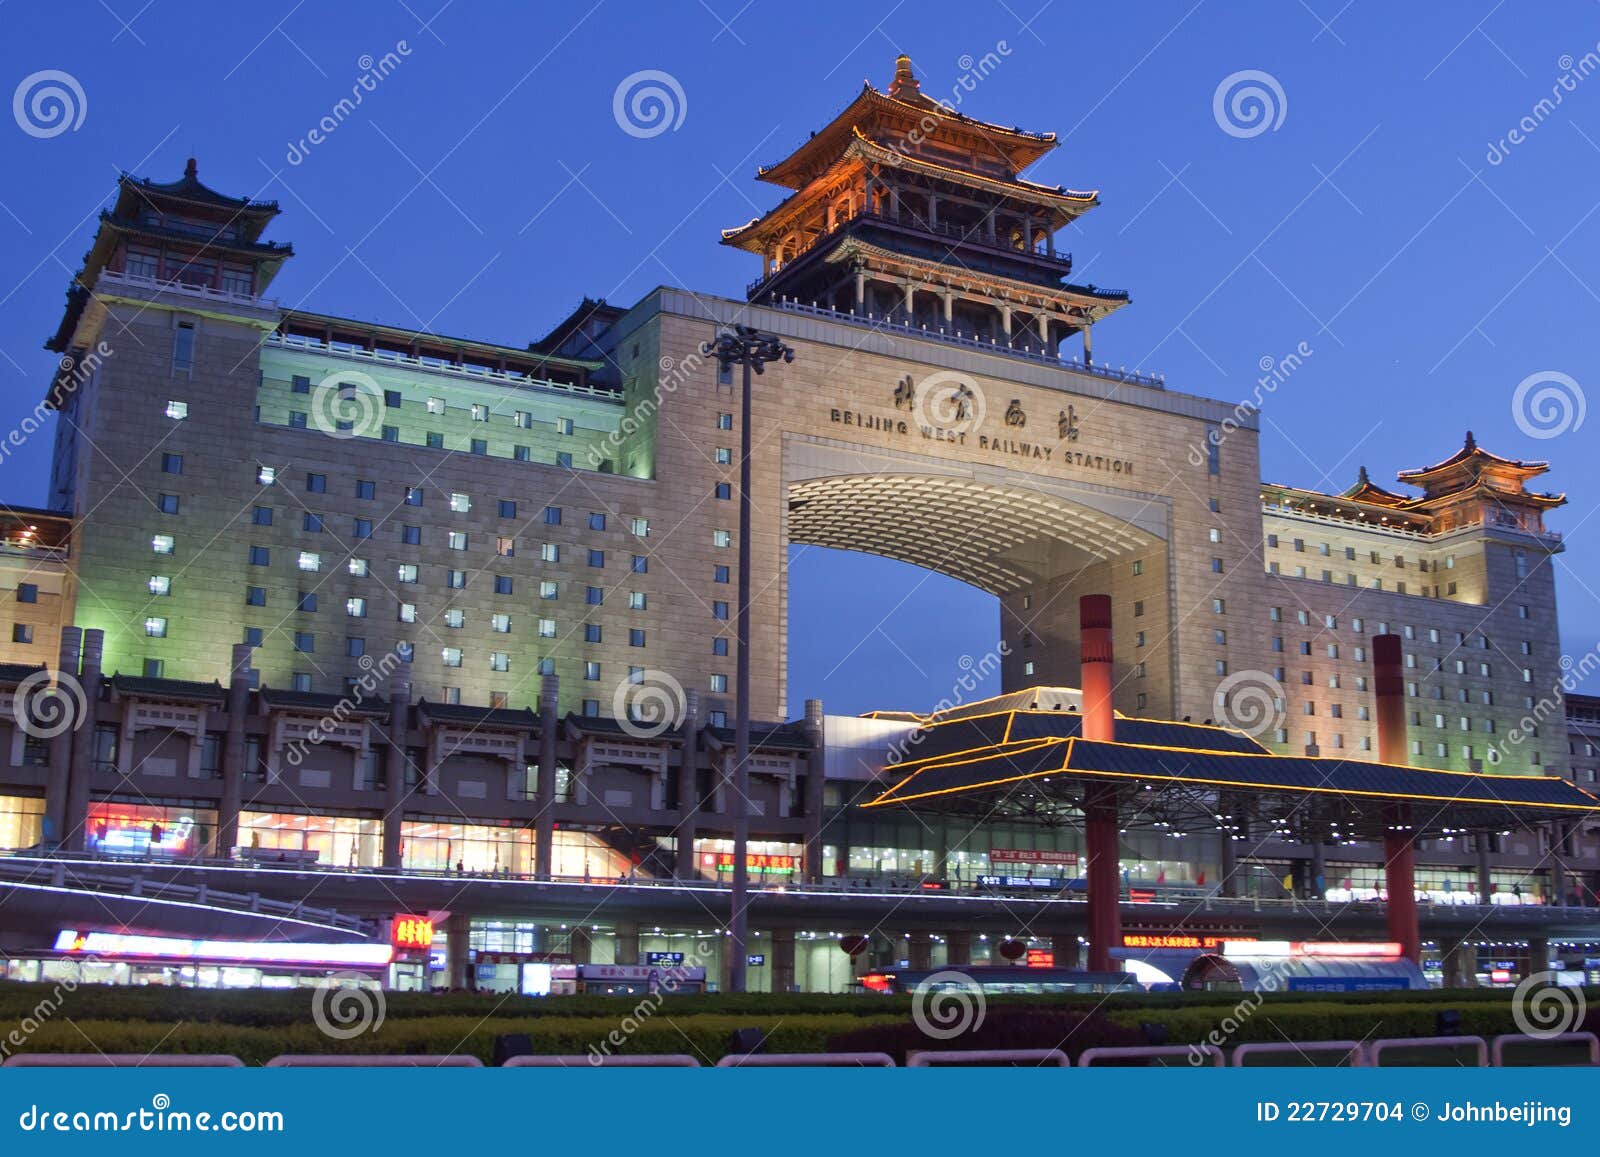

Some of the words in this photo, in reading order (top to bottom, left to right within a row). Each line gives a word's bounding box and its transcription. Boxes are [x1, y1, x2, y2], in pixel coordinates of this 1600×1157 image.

[830, 408, 907, 435] BEIJING
[921, 425, 967, 446] WEST
[979, 435, 1052, 462] RAILWAY
[1064, 451, 1134, 475] STATION
